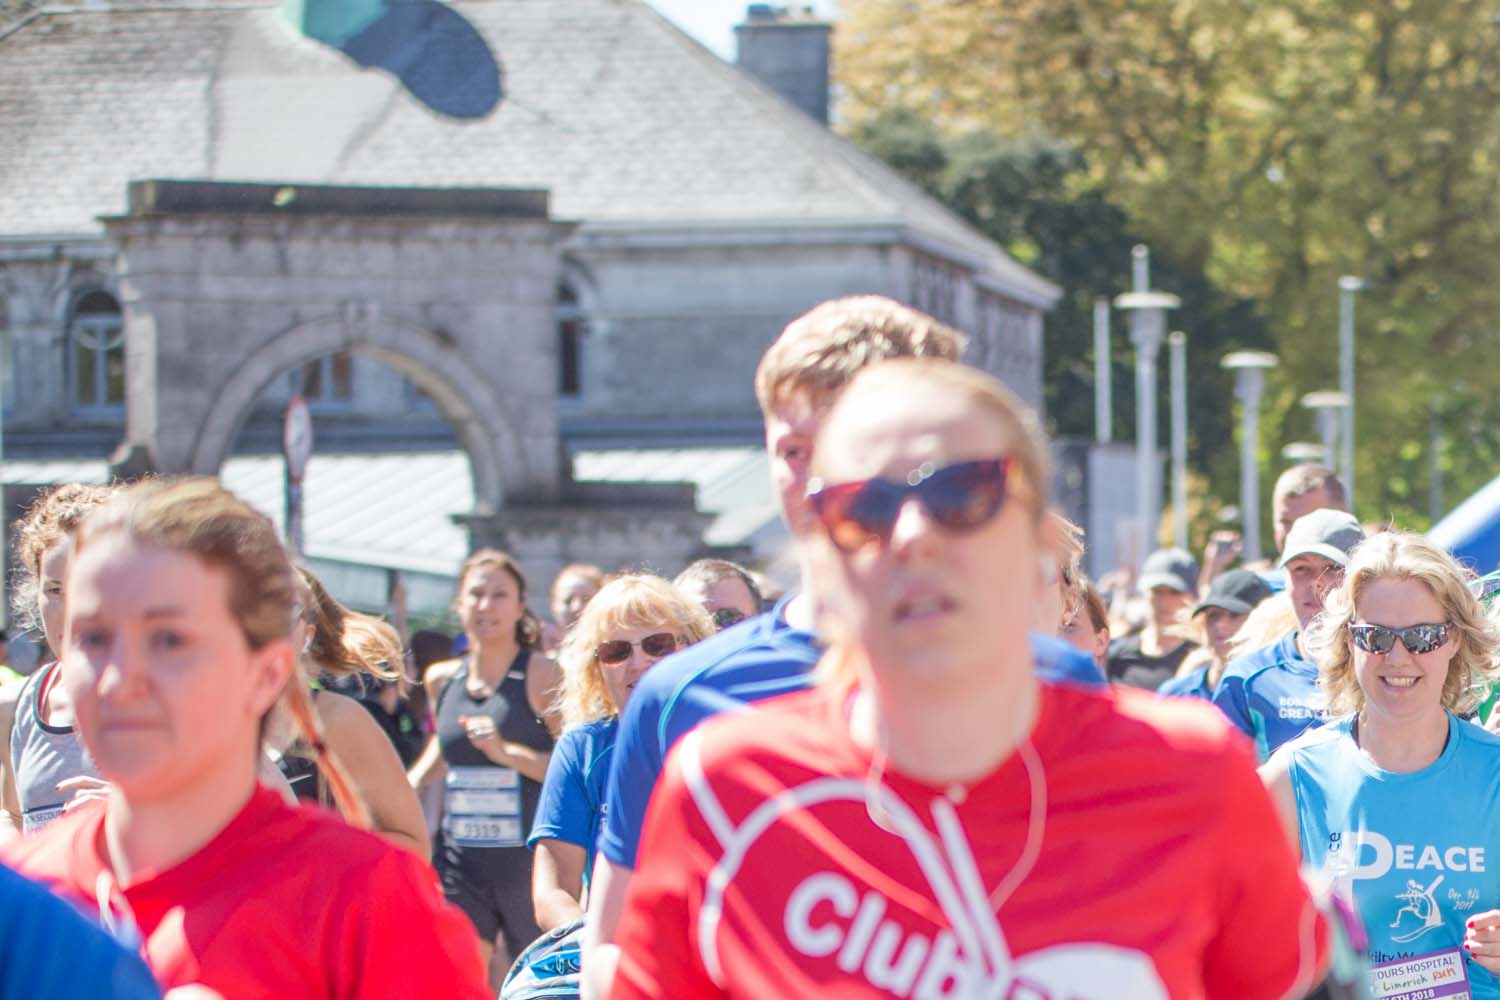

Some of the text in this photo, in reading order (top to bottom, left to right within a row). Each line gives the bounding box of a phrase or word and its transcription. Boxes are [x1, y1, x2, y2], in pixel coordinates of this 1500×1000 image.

[1342, 831, 1486, 912] PEACE
[1377, 967, 1405, 980] OURS
[1406, 956, 1455, 974] HOSPITAL
[1383, 976, 1428, 991] Limerick
